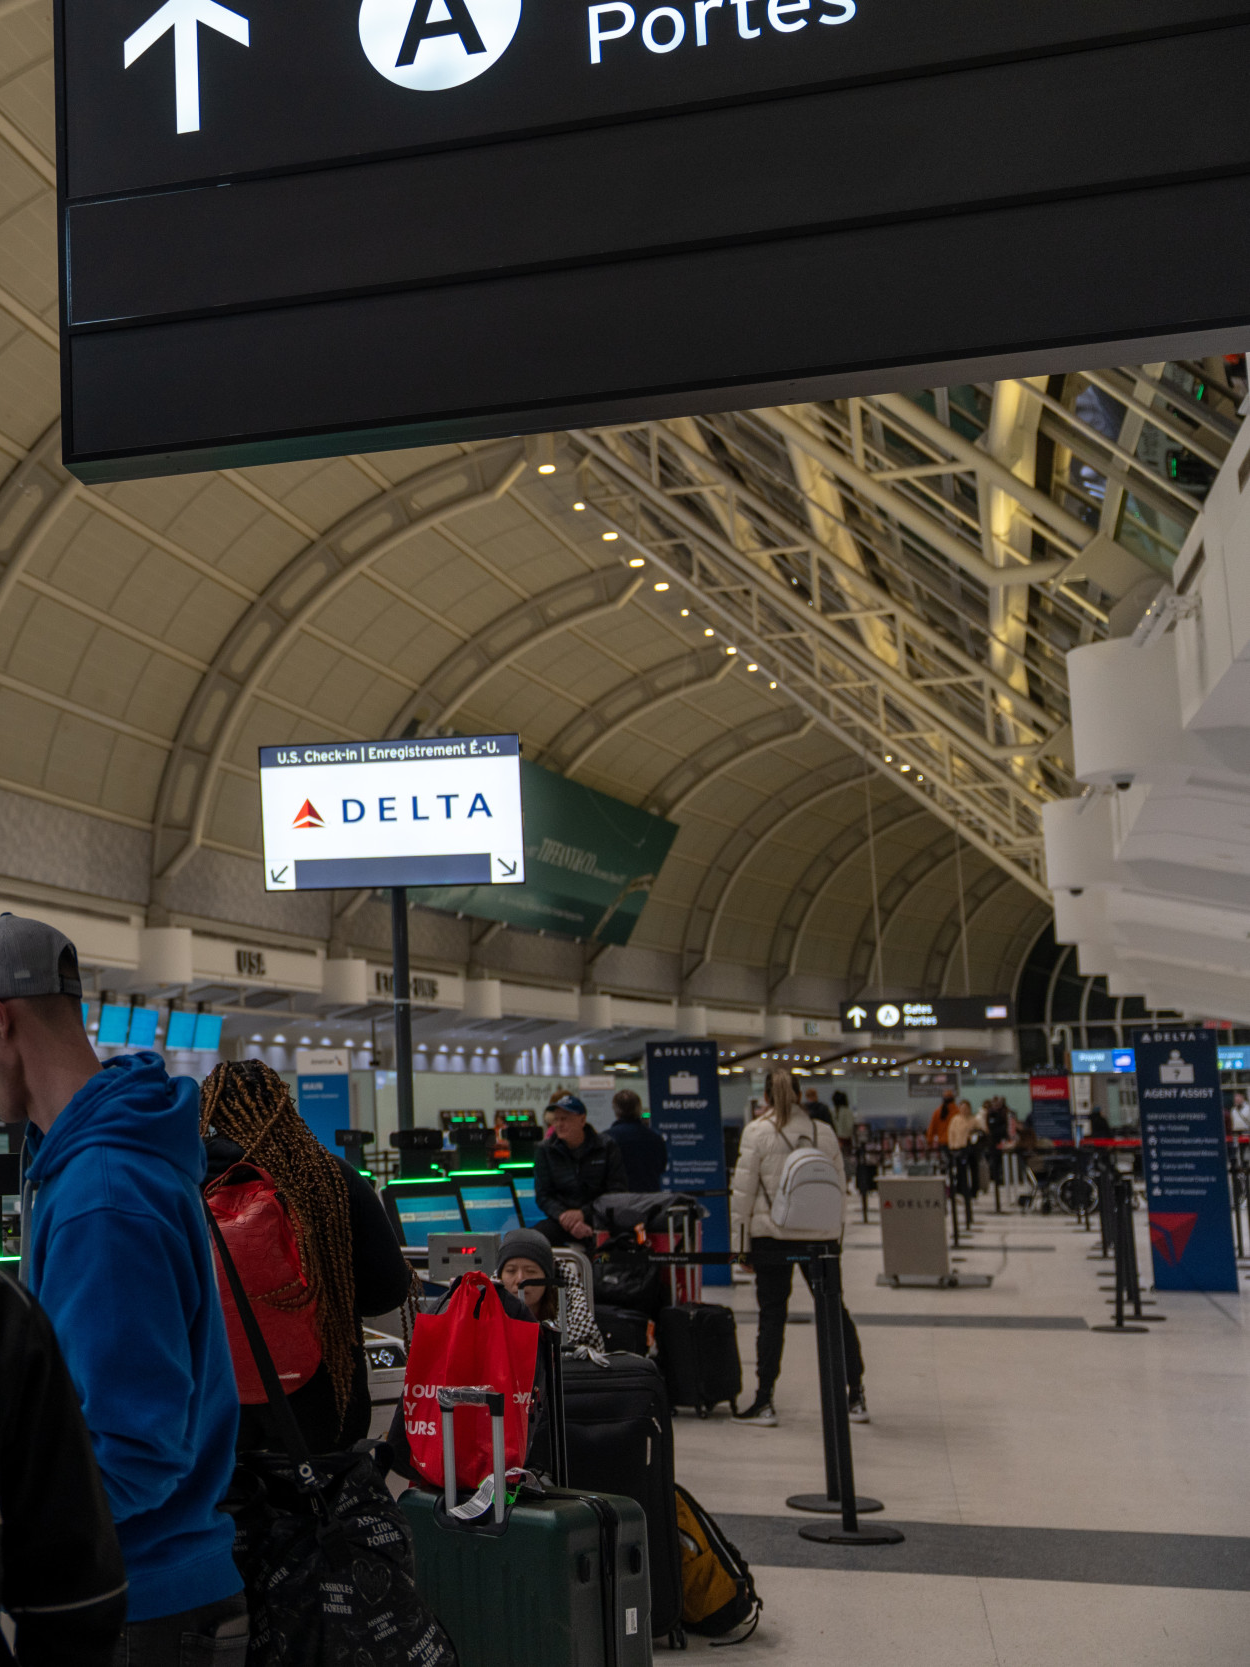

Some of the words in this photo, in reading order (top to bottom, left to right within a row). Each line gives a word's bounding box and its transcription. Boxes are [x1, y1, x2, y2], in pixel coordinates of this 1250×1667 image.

[394, 0, 488, 68] A
[588, 0, 858, 64] Portes
[277, 751, 301, 764] U.S.
[304, 748, 358, 763] Check-in
[368, 742, 466, 761] Enregistrement
[469, 739, 500, 755] É.-U.
[342, 793, 493, 824] DELTA
[1153, 1032, 1197, 1043] DELTA
[664, 1047, 701, 1057] DELTA
[1144, 1088, 1178, 1099] AGENT
[1179, 1087, 1214, 1099] ASSIST
[662, 1099, 681, 1110] BAG
[682, 1099, 709, 1110] DROP
[366, 1530, 403, 1547] FOREVE
[319, 1582, 354, 1595] ASSHOLES
[329, 1592, 345, 1604] LIVE
[322, 1602, 353, 1616] FOREVER
